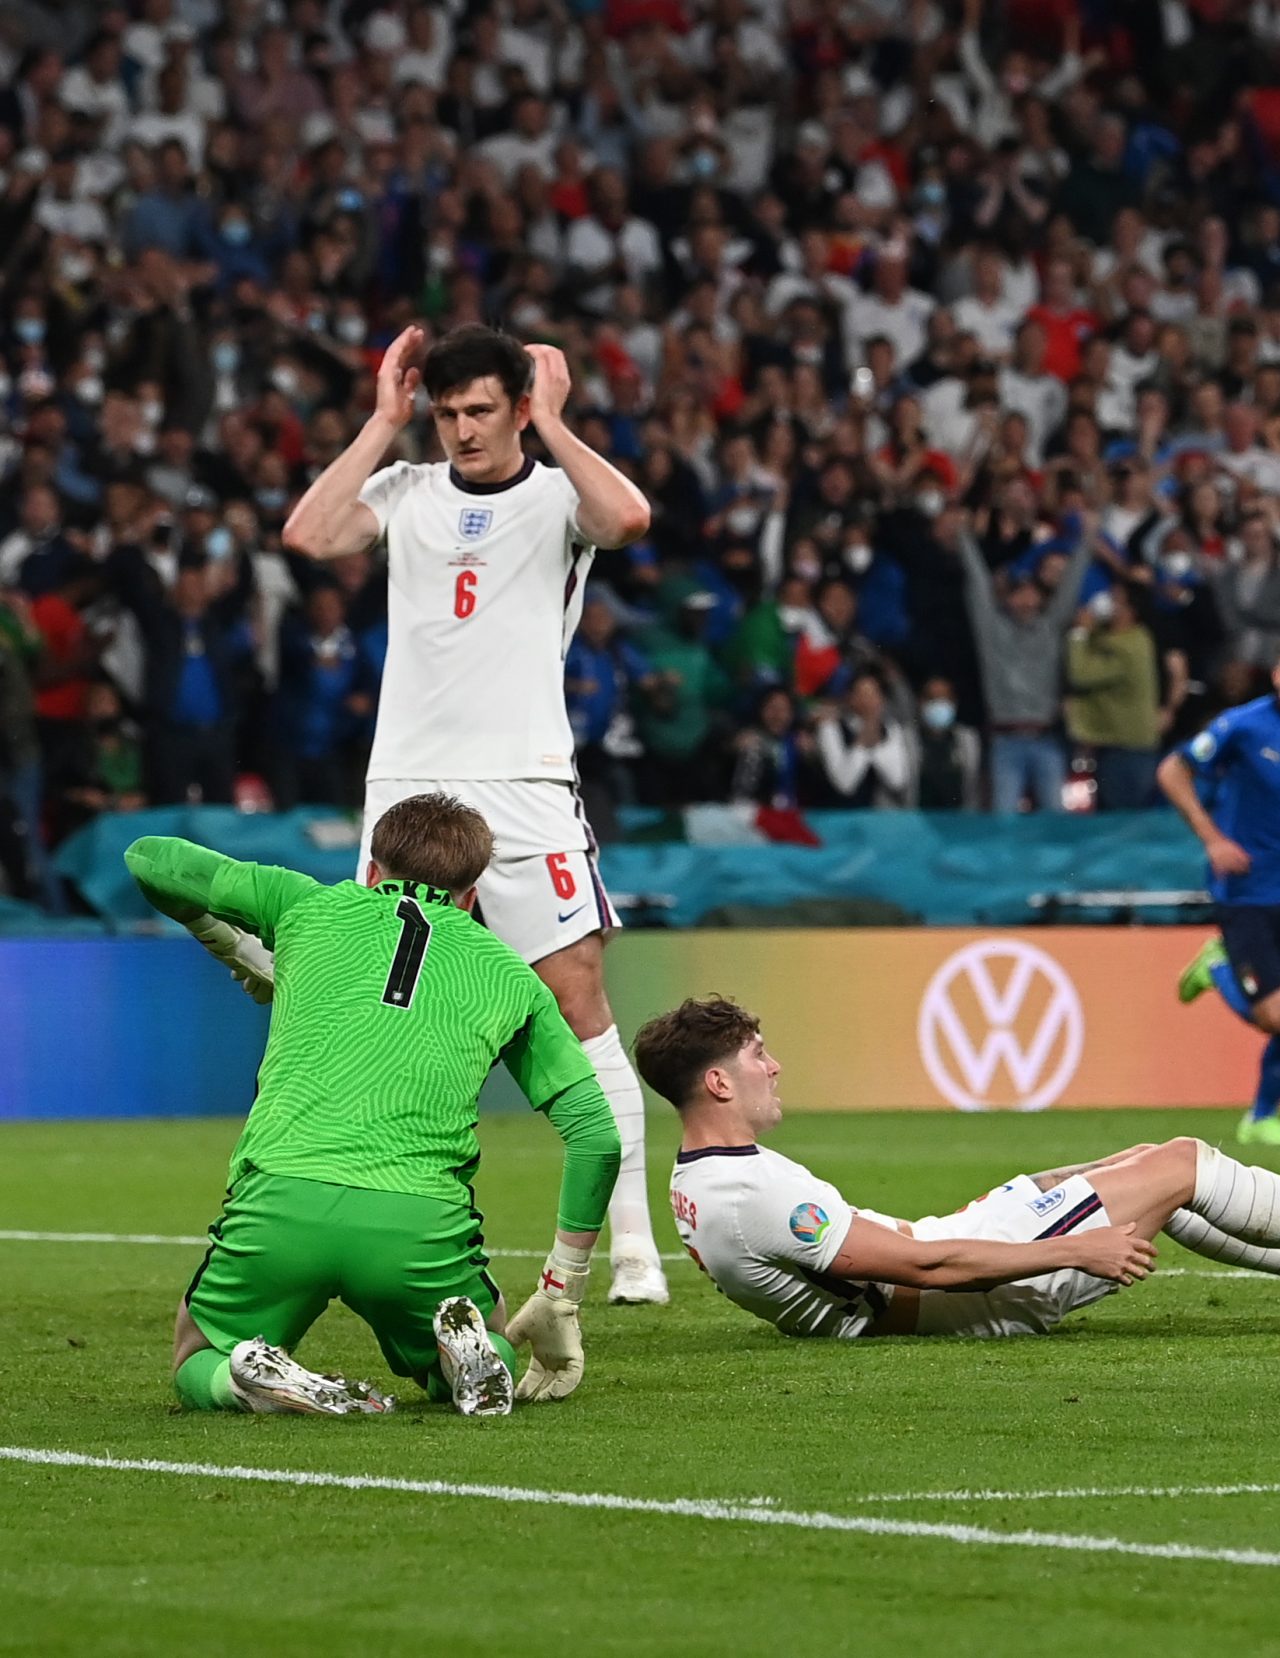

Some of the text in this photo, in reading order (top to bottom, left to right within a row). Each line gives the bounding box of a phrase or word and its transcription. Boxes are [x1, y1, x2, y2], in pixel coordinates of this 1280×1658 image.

[454, 570, 477, 619] 6
[545, 852, 577, 900] 6
[380, 895, 433, 1010] 1
